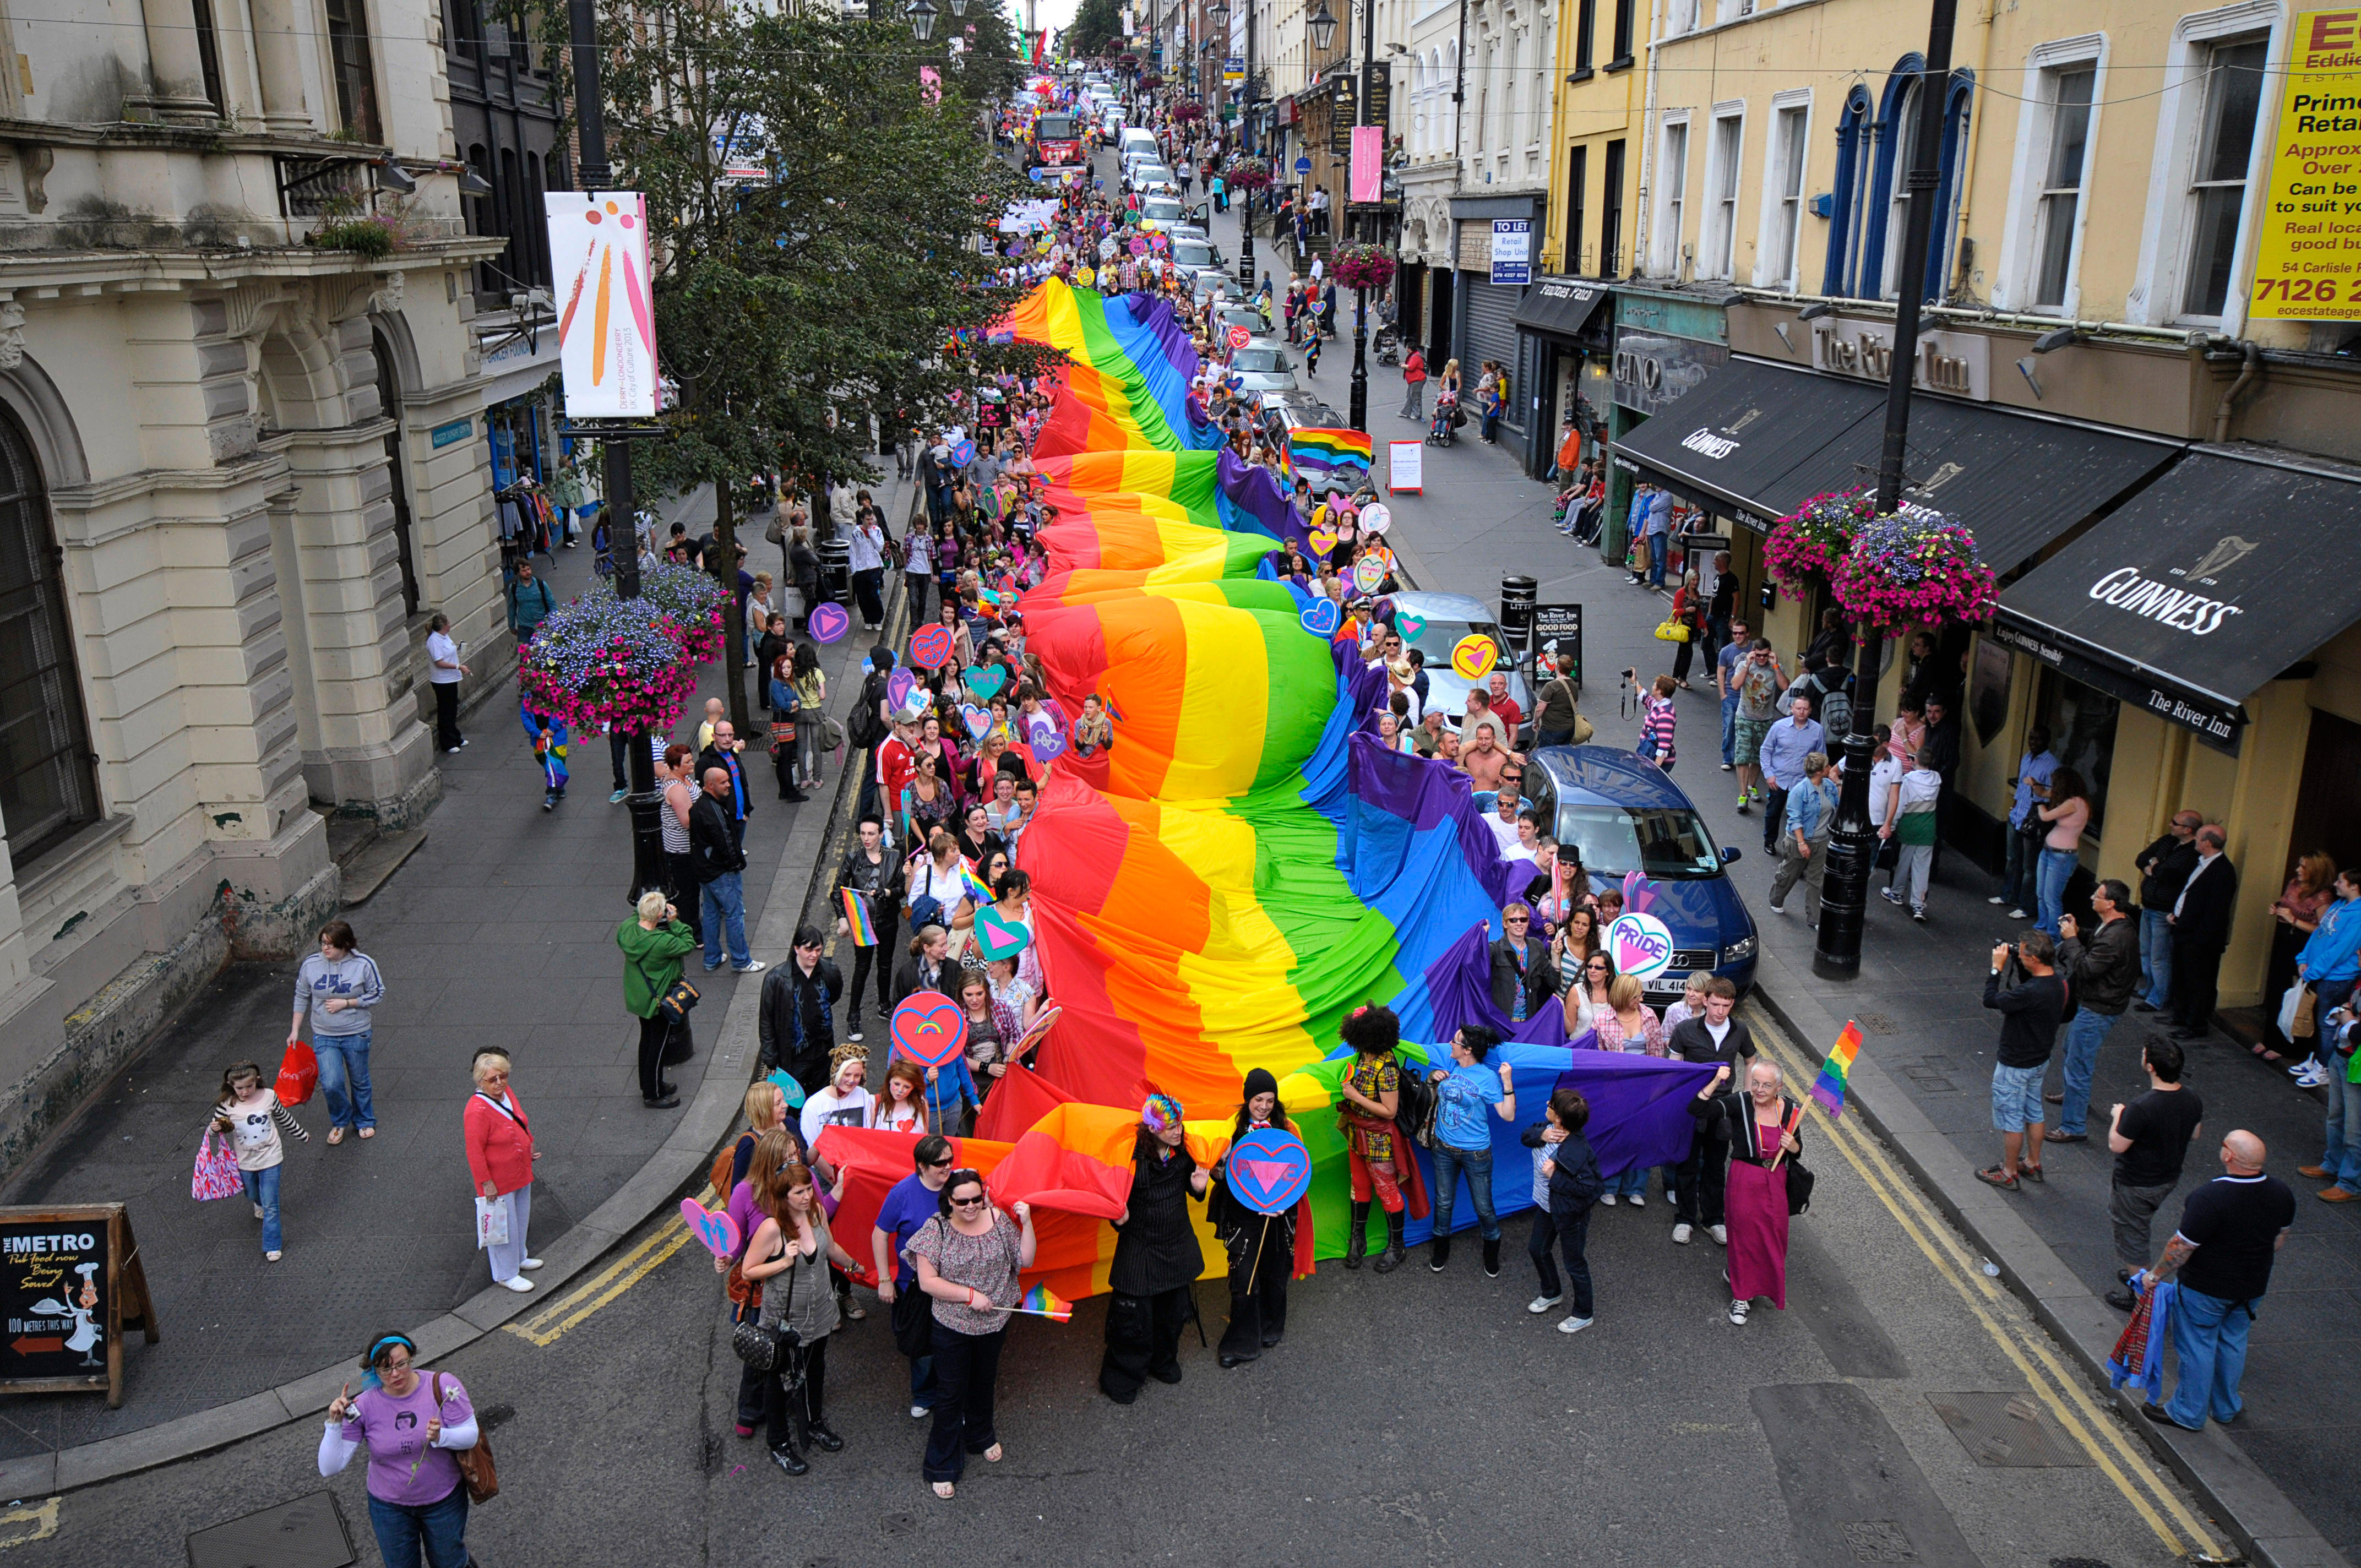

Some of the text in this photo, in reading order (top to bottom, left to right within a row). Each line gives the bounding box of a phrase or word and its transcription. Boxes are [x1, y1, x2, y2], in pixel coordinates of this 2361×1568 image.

[2309, 13, 2361, 51] E
[2306, 52, 2361, 69] Eddie
[2303, 161, 2352, 175] Over
[2289, 182, 2357, 195] Can be
[2276, 202, 2295, 213] to
[2302, 199, 2337, 212] suit
[1497, 222, 1528, 232] TO LET
[2285, 222, 2322, 234] Real
[1495, 248, 1511, 257] Shop
[2291, 238, 2337, 252] good
[2282, 262, 2352, 273] 54 Carlisle
[2256, 279, 2337, 302] 7126
[623, 327, 633, 346] 2013
[510, 338, 540, 358] FOUNDAN
[627, 347, 635, 374] Culture
[1815, 326, 1856, 369] The
[1922, 340, 1971, 390] Inn
[1615, 351, 1661, 391] GINO
[629, 384, 638, 397] City
[630, 400, 637, 409] UK
[1681, 427, 1740, 459] GUINNESS
[1736, 509, 1767, 532] The River Inn
[2089, 567, 2240, 635] GUINNESS
[917, 635, 944, 651] Sweet
[923, 650, 943, 661] GAY
[967, 673, 1000, 684] PRIDE
[907, 690, 927, 709] PRIDE
[966, 713, 989, 727] PRIDE
[2148, 690, 2231, 738] The River Inn
[1615, 922, 1667, 960] PRIDE
[1648, 980, 1664, 990] VIL
[725, 1039, 744, 1068] STREET
[13, 1233, 95, 1253] METRO
[7, 1253, 28, 1264] Pub
[29, 1253, 55, 1265] Food
[30, 1264, 63, 1280] Being
[9, 1318, 74, 1333] 100 METRES THIS WAY
